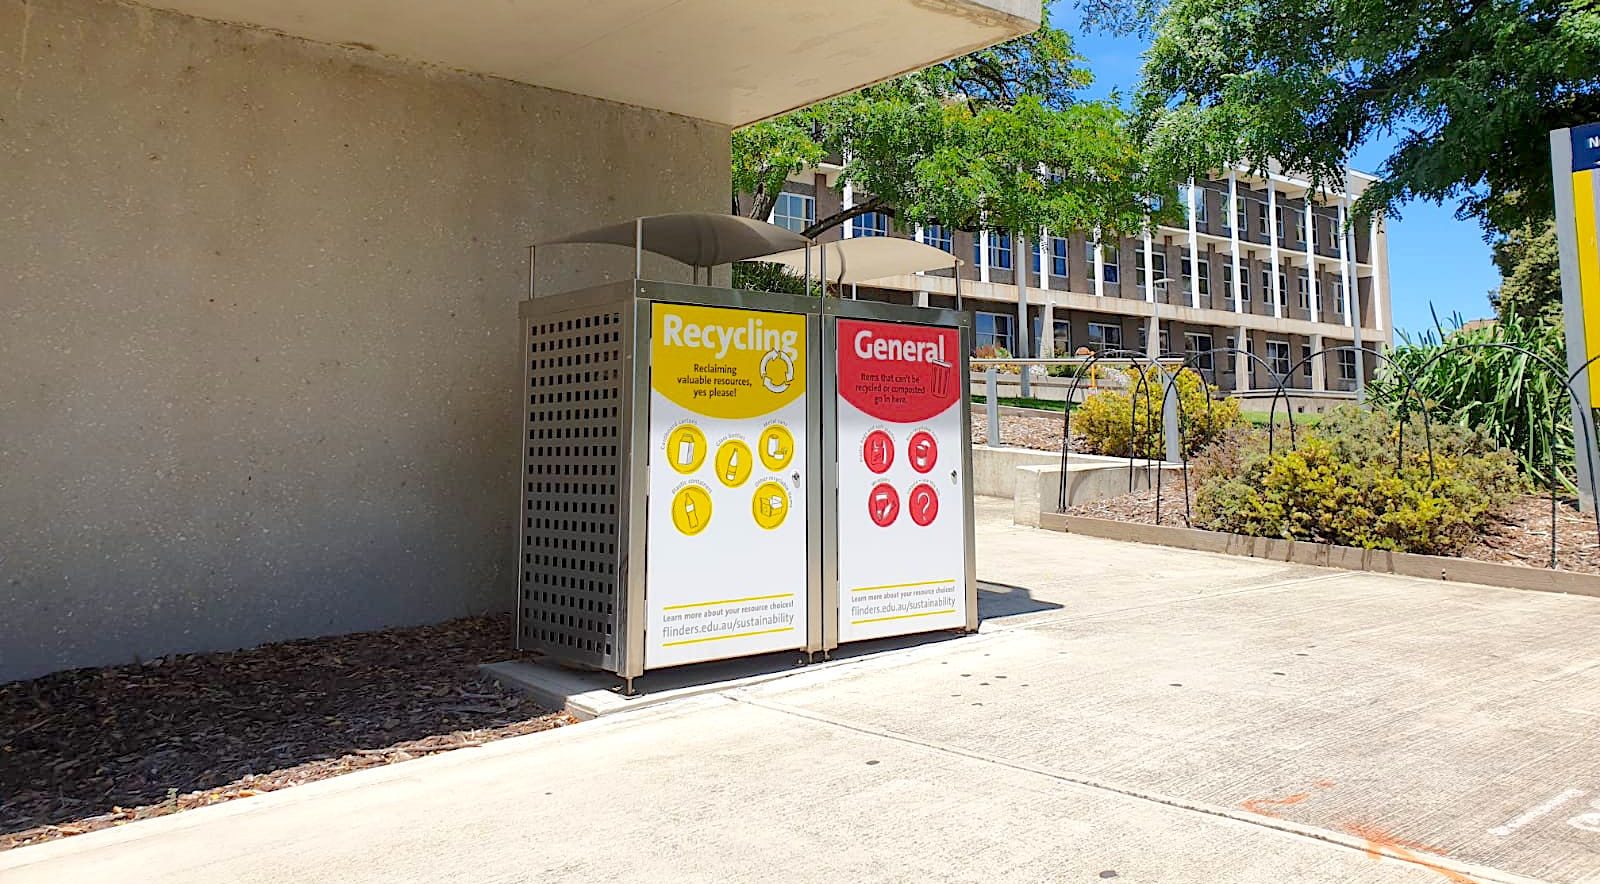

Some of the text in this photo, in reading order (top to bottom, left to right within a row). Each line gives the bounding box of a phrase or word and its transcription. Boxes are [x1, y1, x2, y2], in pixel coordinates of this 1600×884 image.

[663, 313, 798, 361] Recycling
[854, 330, 945, 363] General
[693, 363, 737, 376] Reclaiming
[677, 376, 752, 388] valuable resources,
[861, 373, 920, 383] Items that can't be
[693, 388, 737, 399] yes please!
[855, 384, 881, 394] recycled
[891, 386, 925, 395] composted
[874, 396, 883, 405] go
[883, 394, 891, 403] in
[851, 595, 867, 603] Learn
[883, 592, 899, 600] about
[900, 591, 912, 600] your
[935, 586, 955, 594] choices!
[663, 600, 794, 623] Learn more about your resource choices!
[851, 597, 956, 616] flinders.edu.au/sustainability
[662, 613, 795, 638] flinders.edu.au/sustainability
